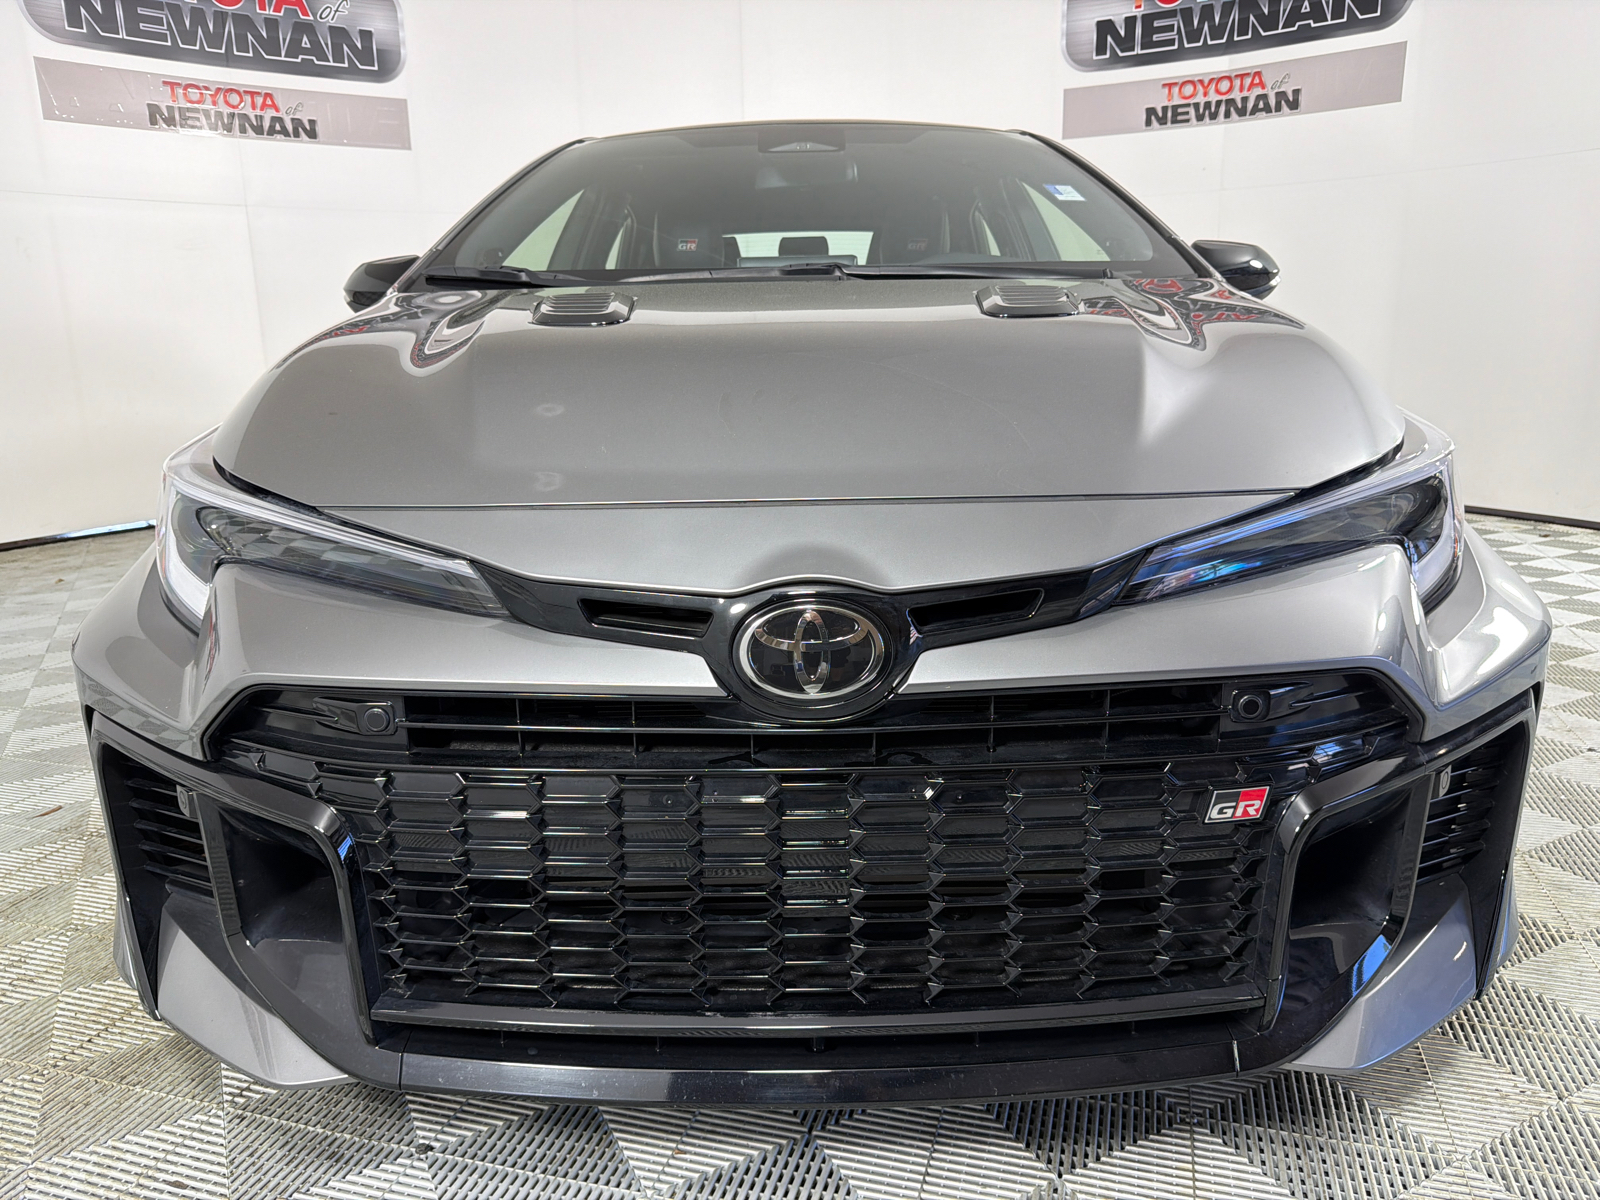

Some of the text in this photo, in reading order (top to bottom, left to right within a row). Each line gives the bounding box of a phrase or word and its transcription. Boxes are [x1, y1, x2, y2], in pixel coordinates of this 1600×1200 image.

[316, 0, 350, 22] of
[62, 0, 378, 70] NEWNAN
[162, 80, 303, 116] TOYOTA of
[1162, 71, 1290, 102] TOYOTA of
[146, 103, 318, 140] NEWNAN
[1145, 88, 1301, 127] NEWNAN
[1209, 799, 1262, 820] GR
